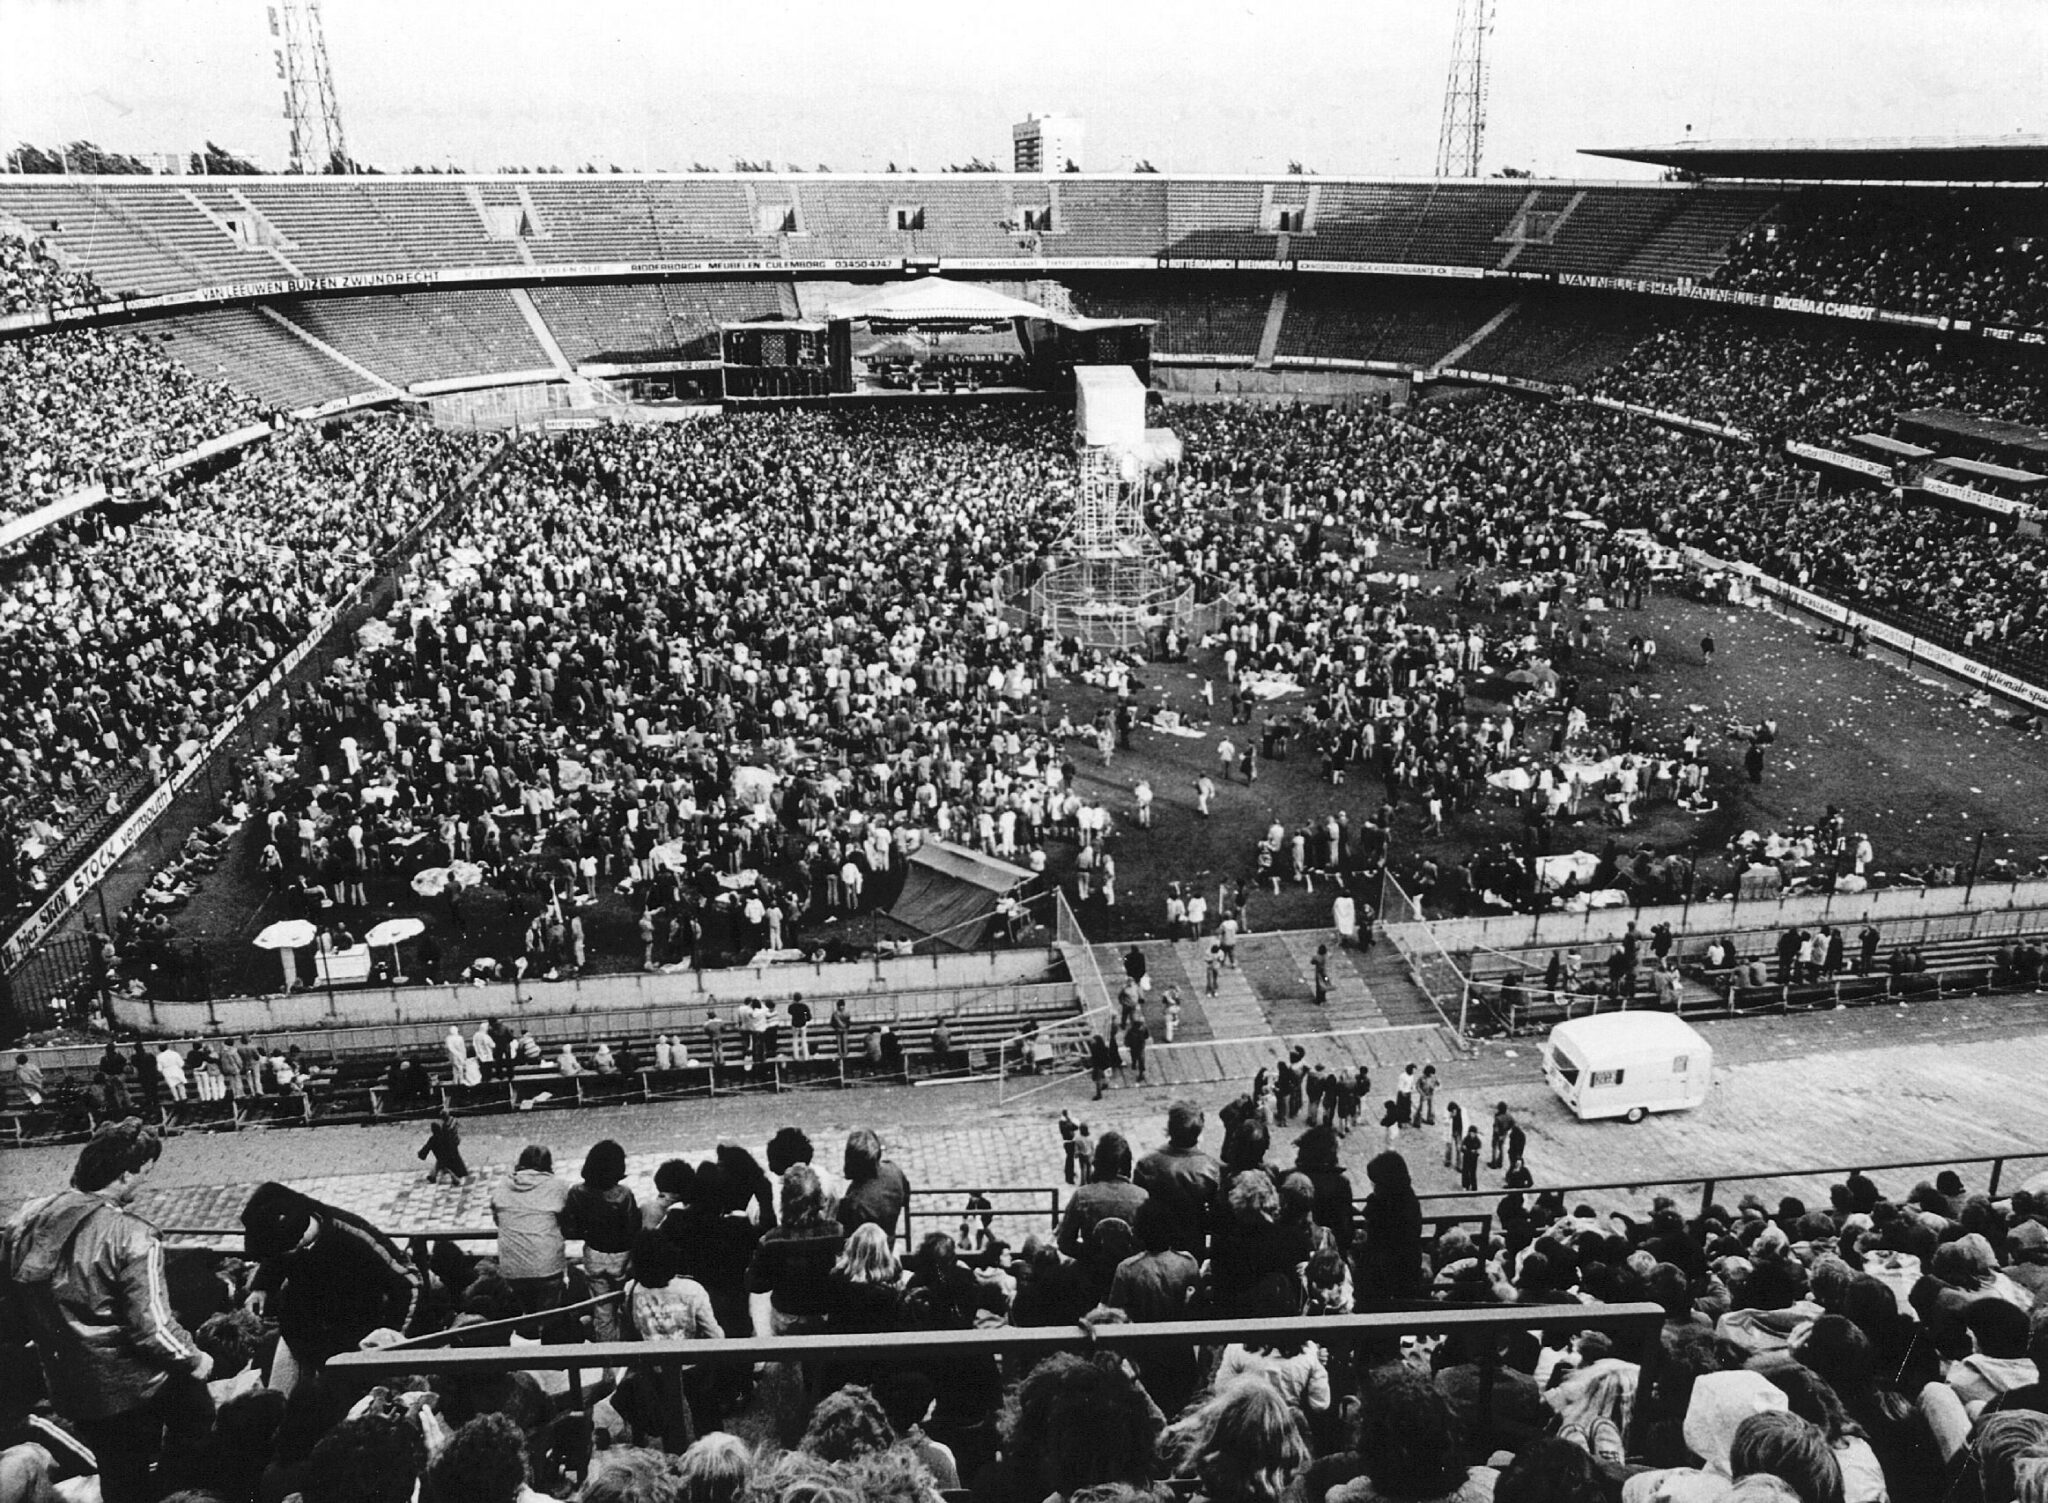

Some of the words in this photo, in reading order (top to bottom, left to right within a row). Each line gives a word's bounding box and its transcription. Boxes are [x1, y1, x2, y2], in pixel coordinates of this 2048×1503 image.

[708, 261, 760, 270] MEUBELEN
[765, 260, 826, 268] CULEMBORG
[201, 287, 224, 300] VAN
[226, 281, 283, 298] LEEUWEN
[288, 278, 337, 292] BUIZEN
[342, 271, 439, 287] ZWIJNDRECHT
[1773, 296, 1815, 313] DIKEMA
[1825, 302, 1875, 321] CHABOT
[1982, 327, 2015, 340] STREET
[74, 842, 116, 896] STOCK
[121, 791, 169, 847] vermouth
